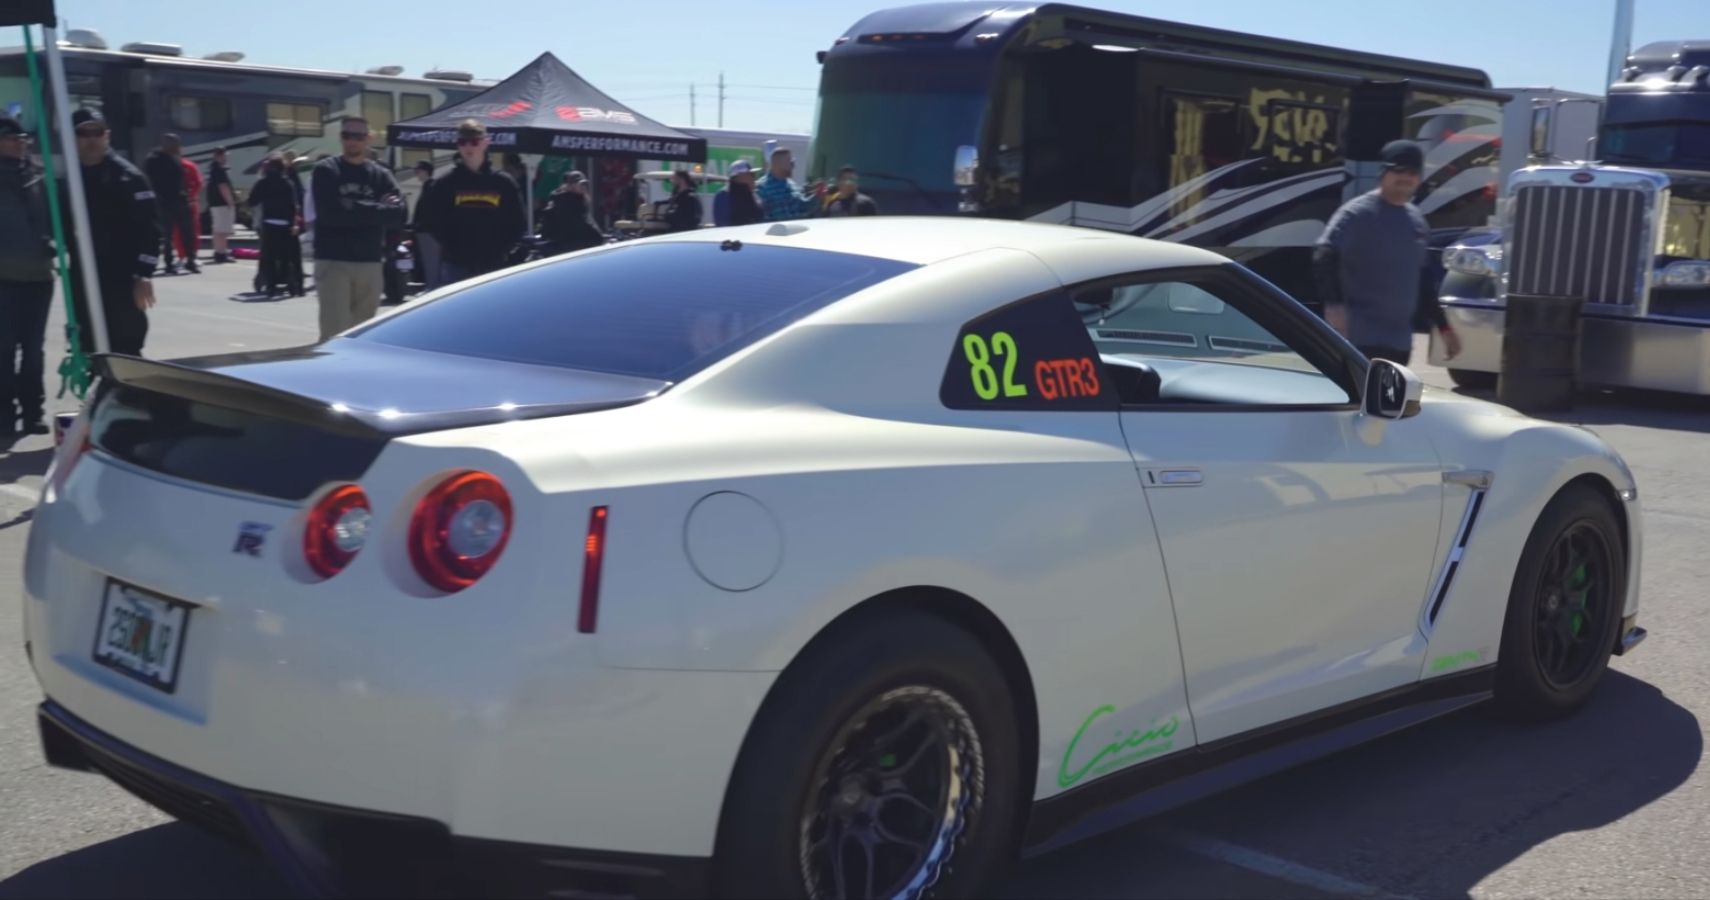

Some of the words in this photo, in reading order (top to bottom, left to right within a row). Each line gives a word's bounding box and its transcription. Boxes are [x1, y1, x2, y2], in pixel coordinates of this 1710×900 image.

[552, 135, 689, 156] AMSPERFORMANCE.COM
[963, 331, 1028, 400] 82
[1035, 357, 1100, 400] GTR3
[1058, 703, 1180, 788] Cicio
